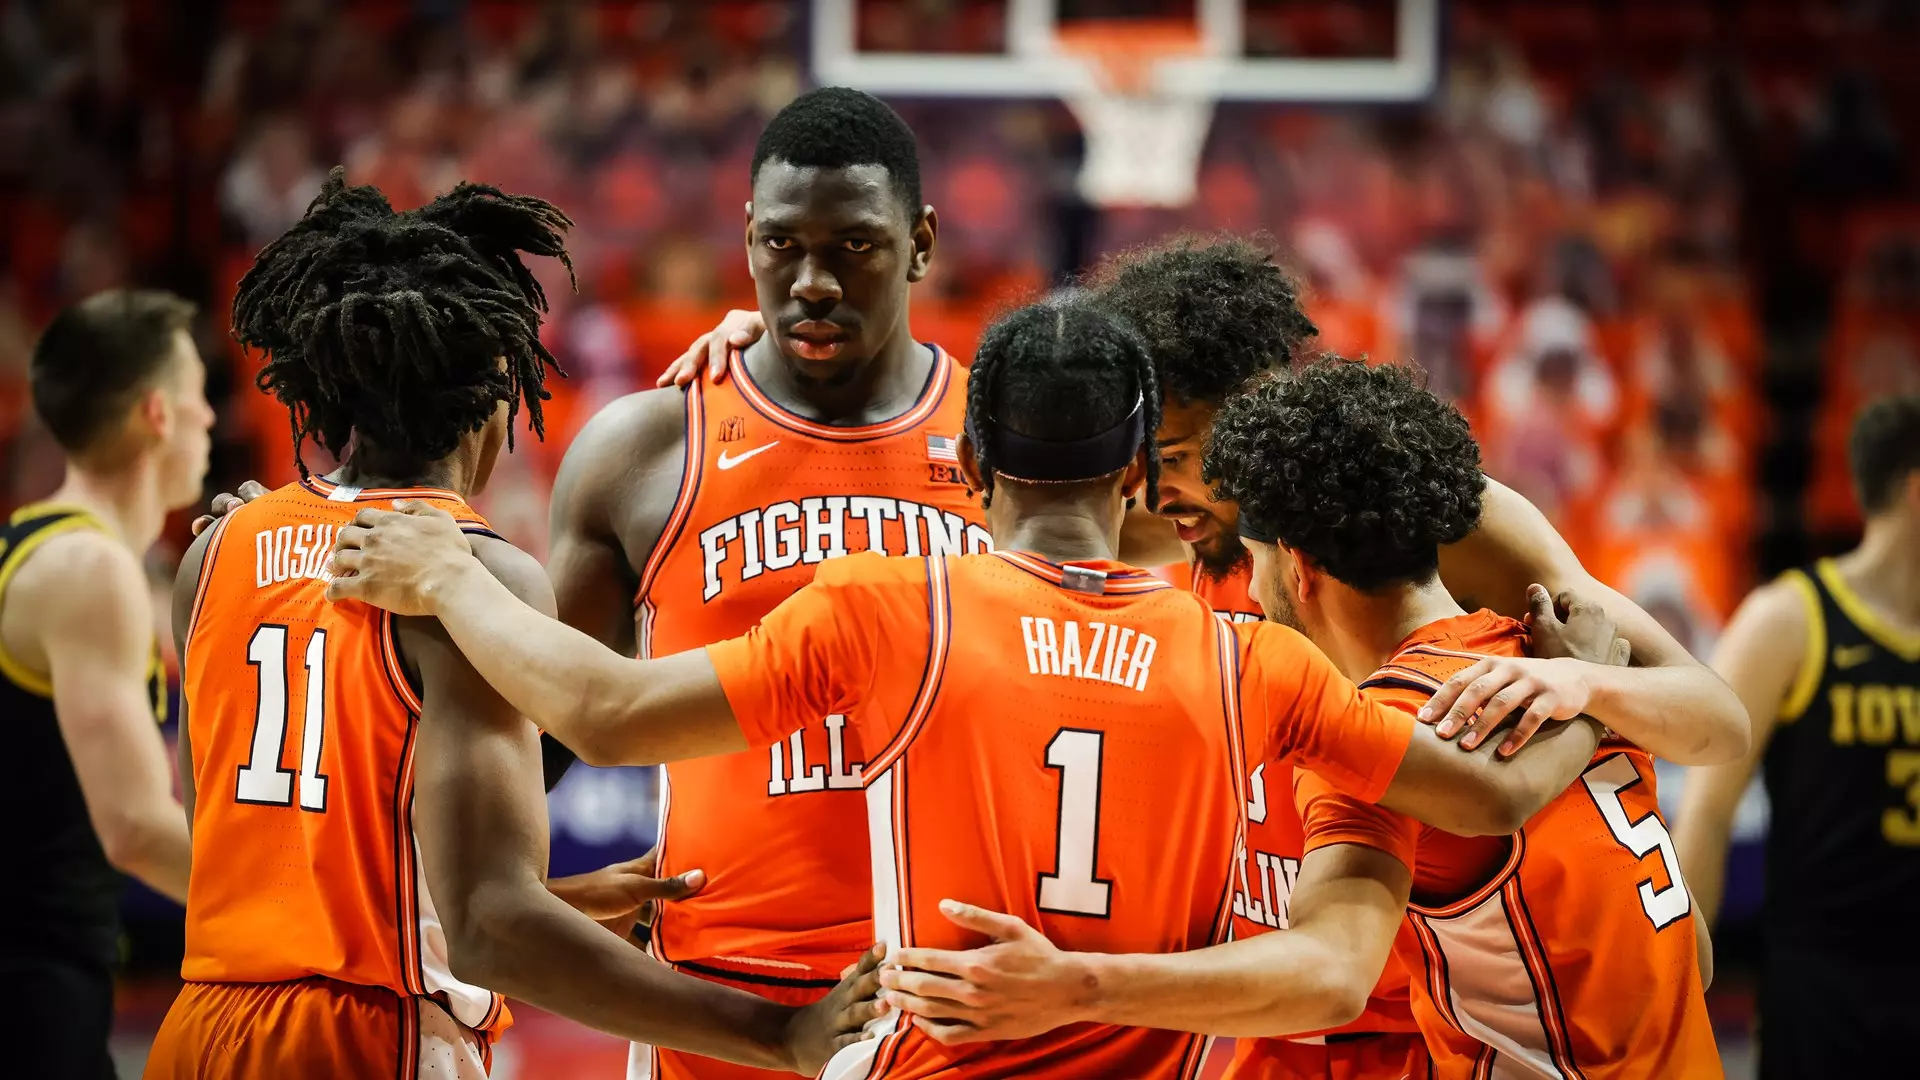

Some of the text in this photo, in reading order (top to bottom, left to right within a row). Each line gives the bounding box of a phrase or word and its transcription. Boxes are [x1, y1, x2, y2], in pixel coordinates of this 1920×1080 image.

[256, 523, 343, 588] DOSU
[235, 623, 328, 813] 11
[1020, 616, 1157, 691] FRAZIER
[1037, 726, 1113, 920] 1
[1579, 751, 1691, 933] 5
